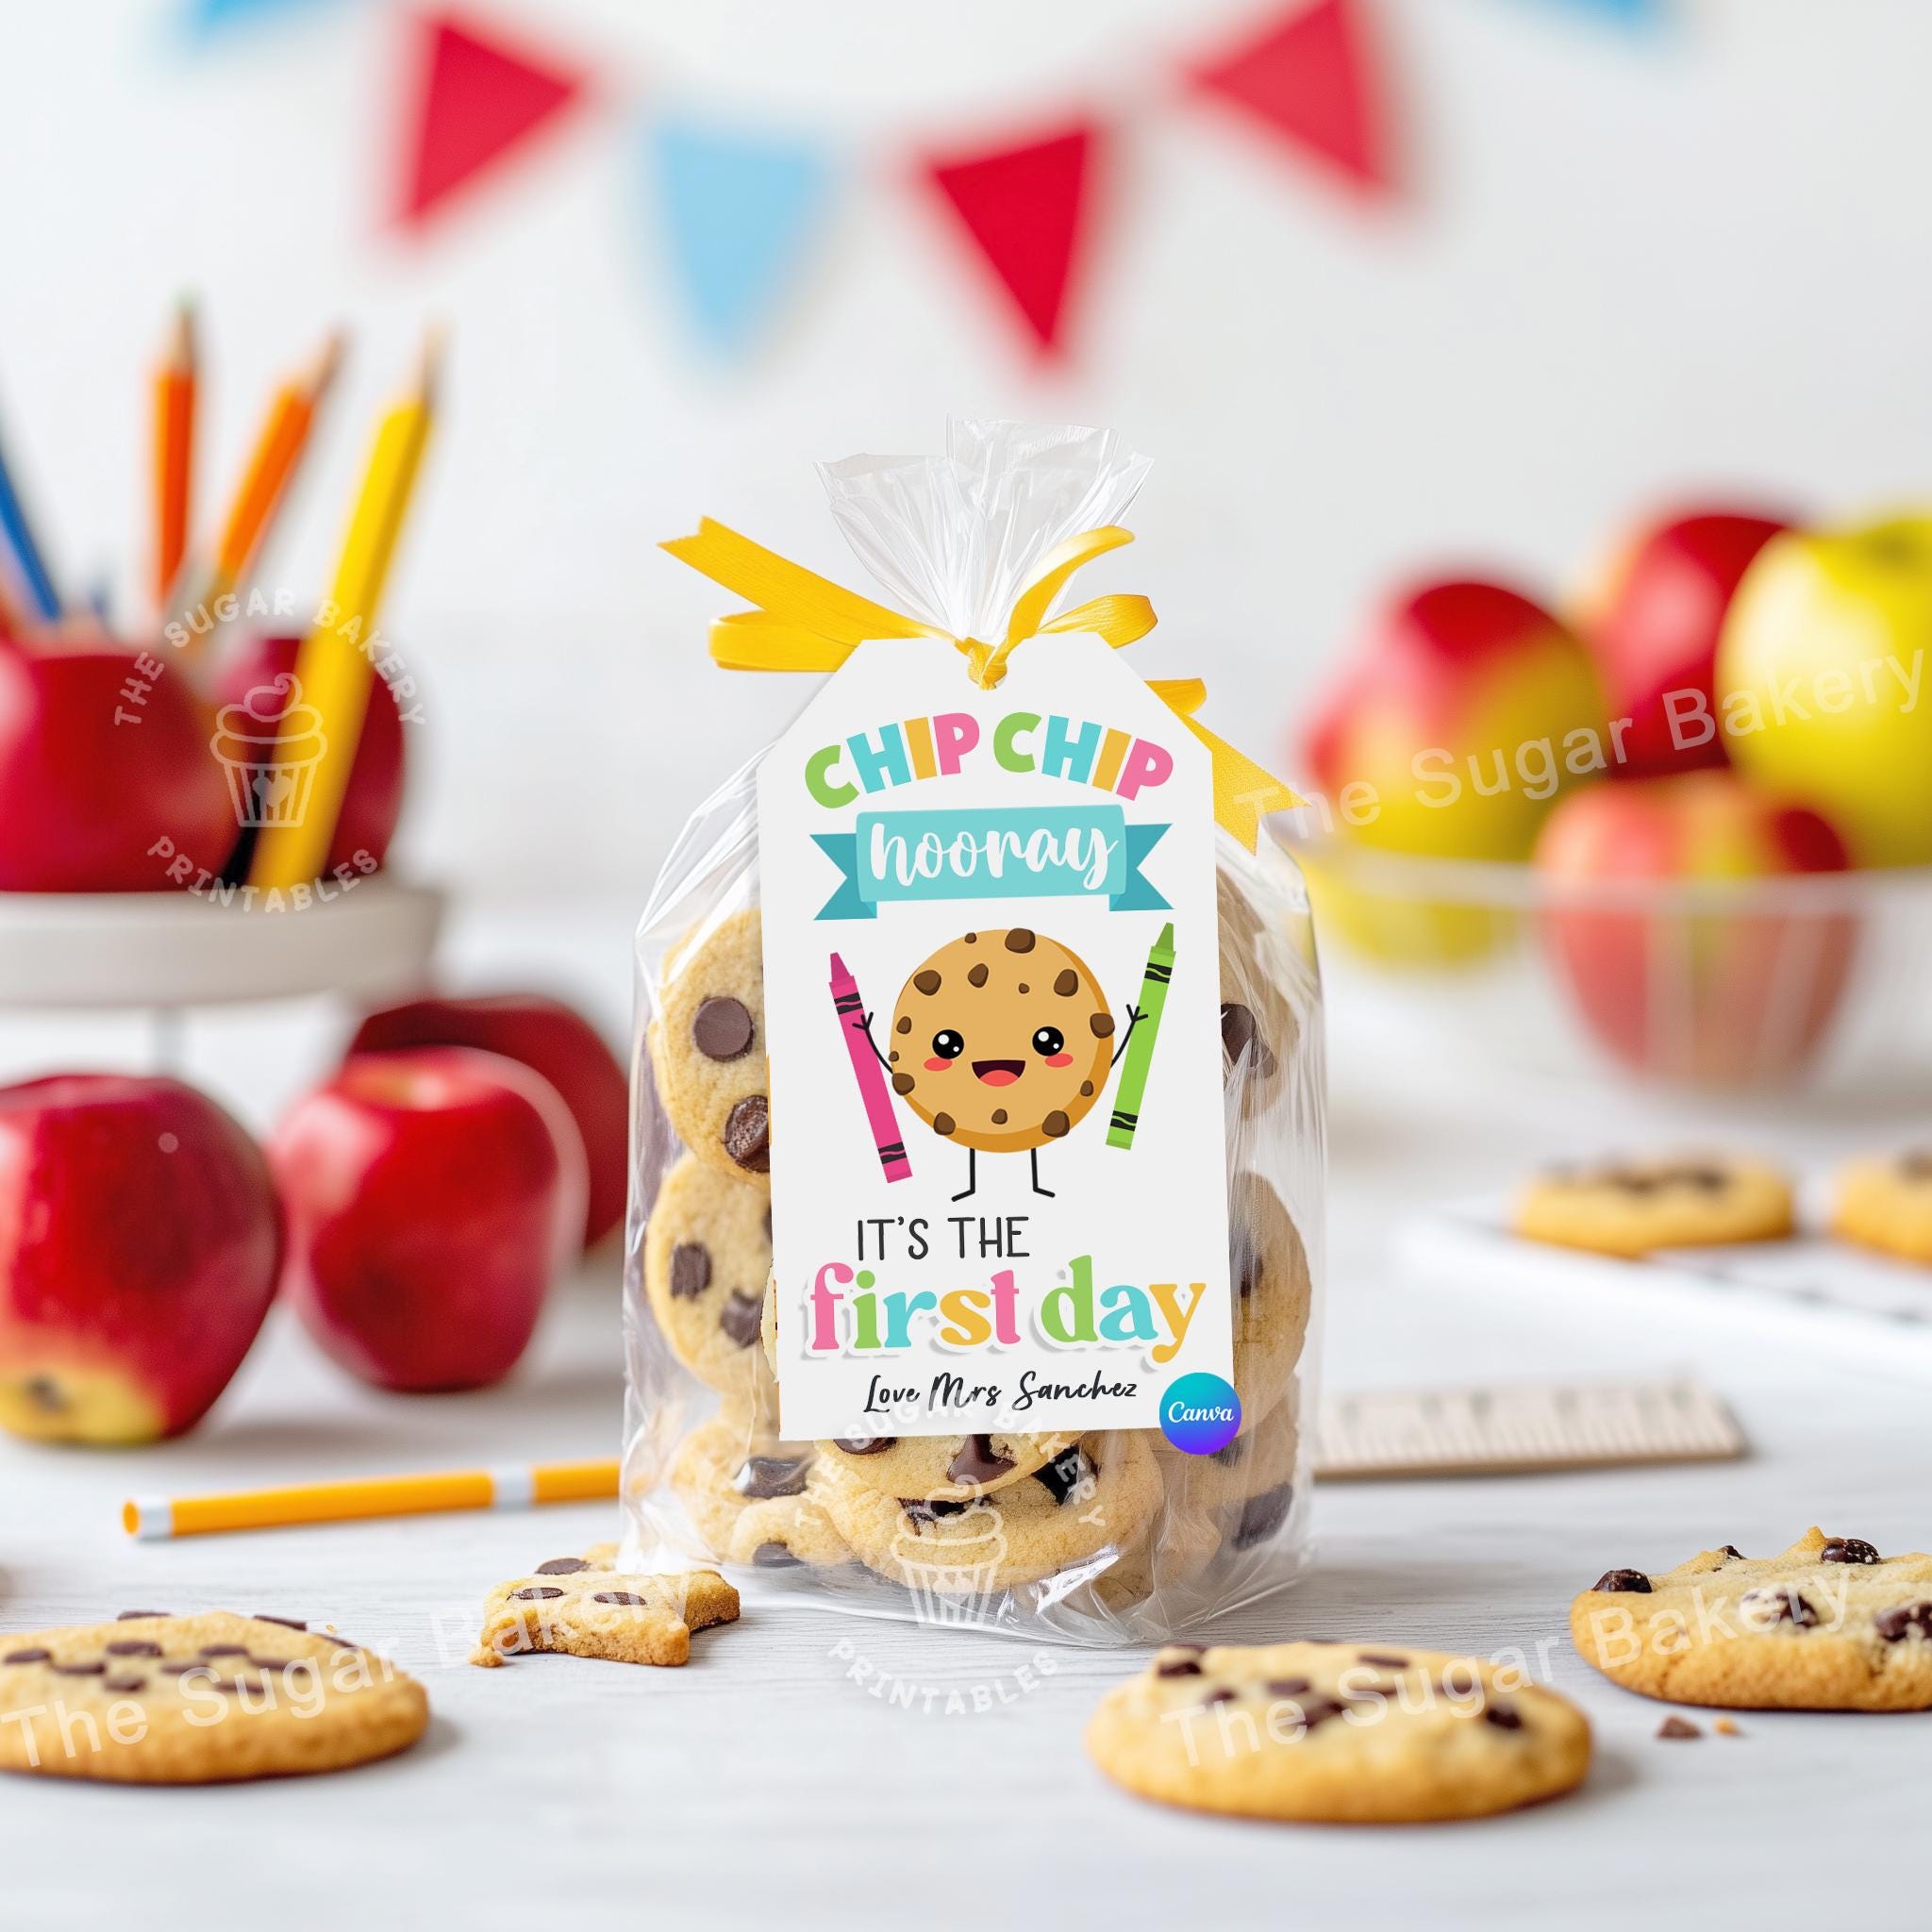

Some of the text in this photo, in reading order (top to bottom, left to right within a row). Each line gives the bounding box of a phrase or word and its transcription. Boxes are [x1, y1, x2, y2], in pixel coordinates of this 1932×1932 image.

[805, 712, 1174, 808] CHIP CHIP
[870, 823, 1119, 891] hooray
[948, 1216, 1030, 1258] THE
[810, 1255, 1206, 1364] first day
[862, 1370, 1138, 1414] Love Mrs Sanchez
